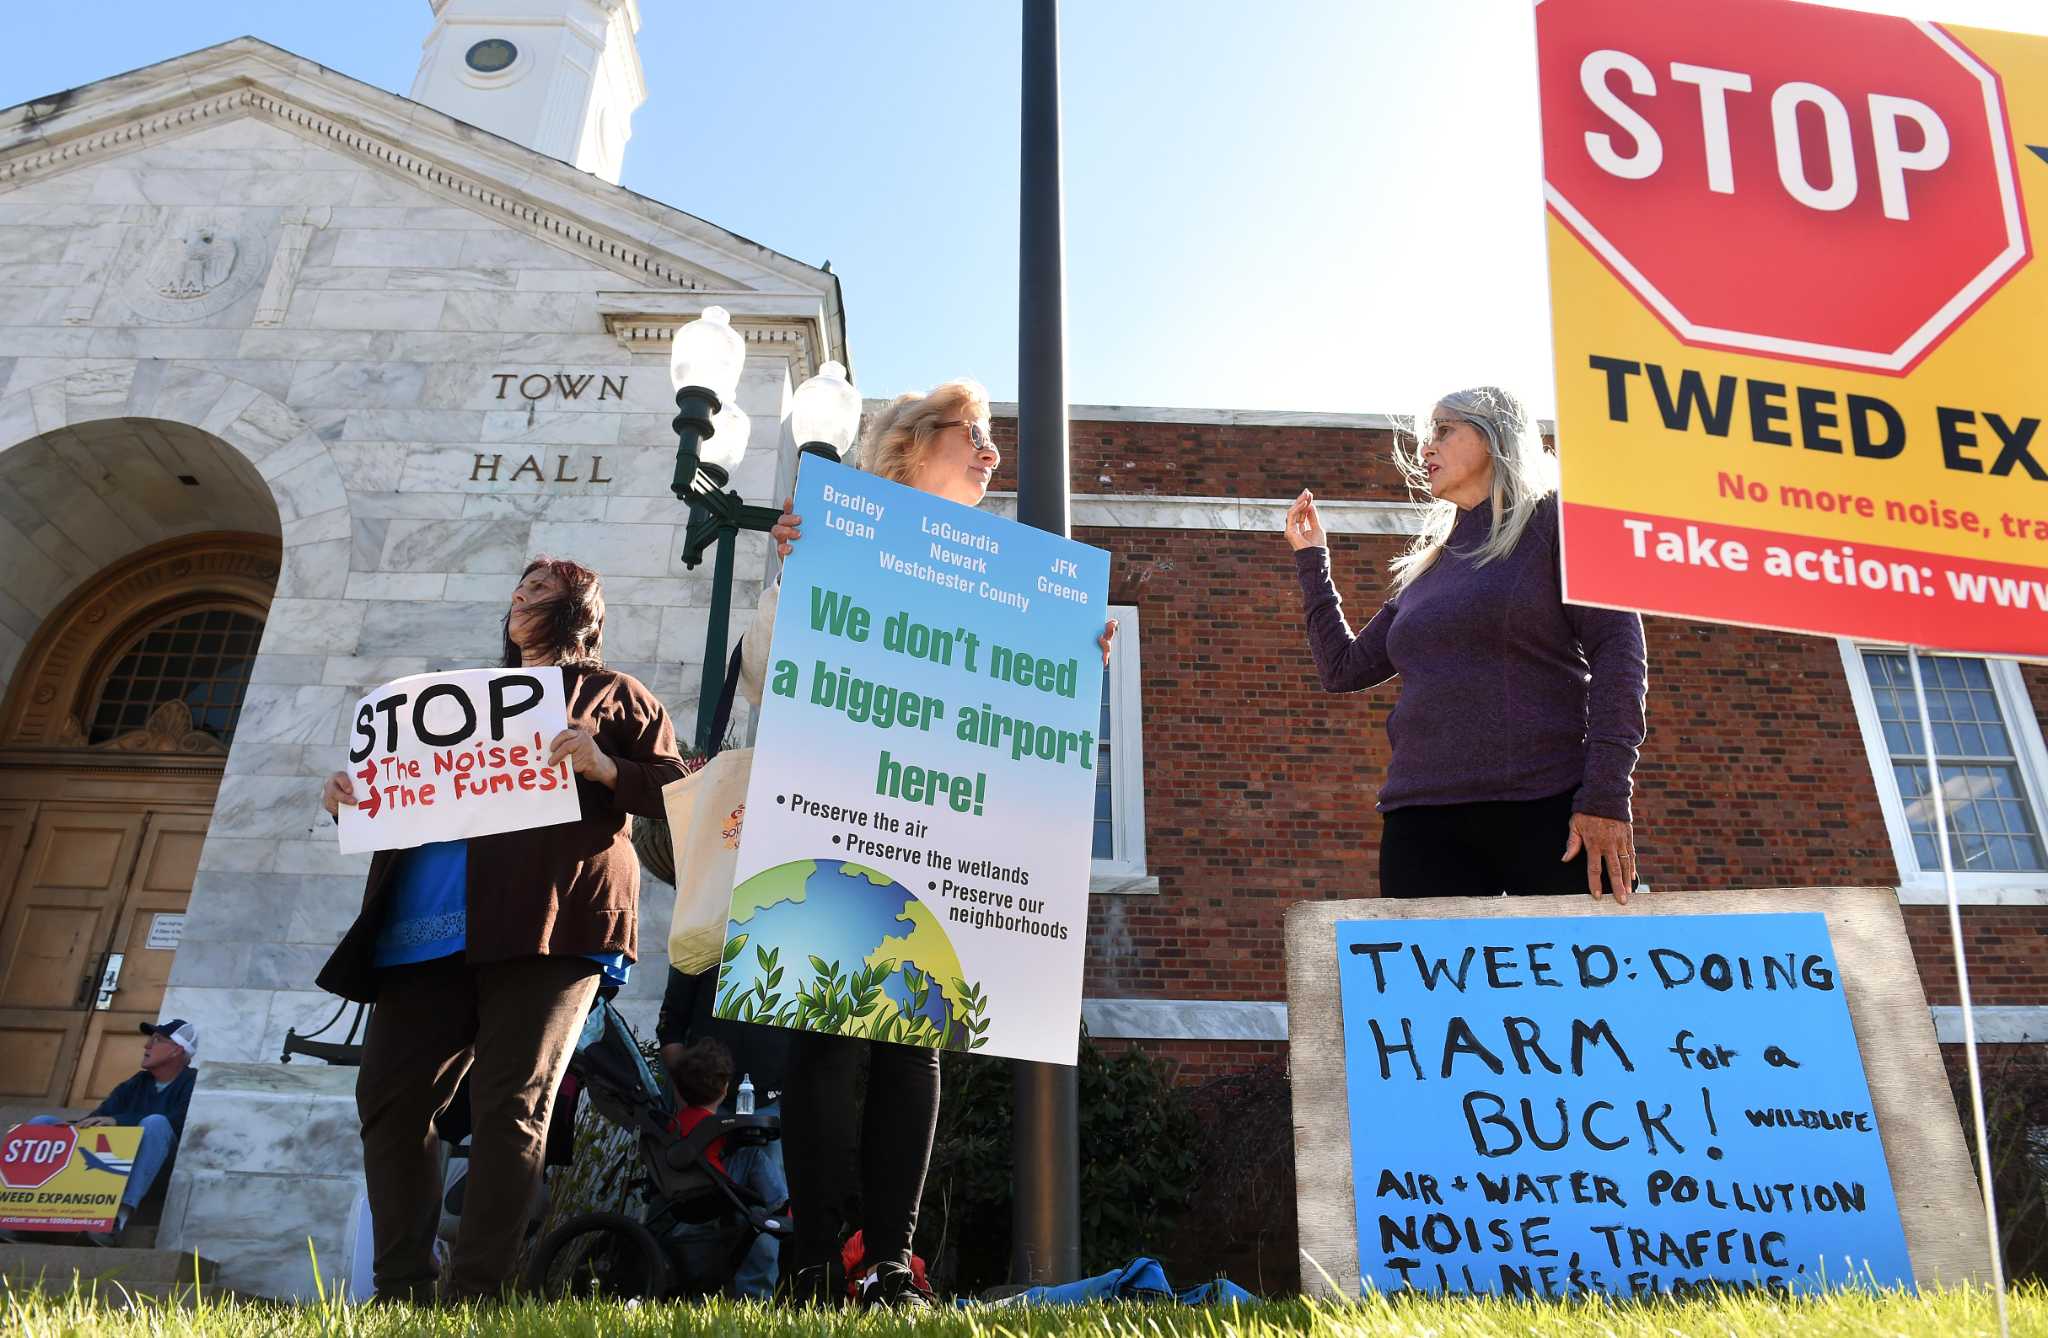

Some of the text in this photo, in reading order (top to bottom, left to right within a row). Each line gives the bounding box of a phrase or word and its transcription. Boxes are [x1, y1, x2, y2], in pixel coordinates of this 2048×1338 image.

[1580, 49, 1950, 221] STOP
[492, 373, 629, 401] TOWN
[1589, 354, 1907, 460] TWEED
[469, 454, 612, 483] HALL
[824, 484, 884, 521] Bradley
[826, 511, 875, 540] Logan
[1717, 471, 1768, 503] No
[1780, 485, 1874, 518] more
[1885, 499, 1990, 539] noise,
[922, 516, 999, 554] LaGuardia
[930, 543, 987, 574] Newark
[1623, 518, 1749, 572] Take
[1764, 546, 1936, 597] action:
[880, 551, 1030, 612] Westchester County
[1037, 576, 1089, 604] Greene
[1051, 558, 1078, 578] JFK
[810, 586, 1078, 699] We don't need
[350, 675, 544, 763] STOP
[771, 659, 1095, 770] a bigger airport
[381, 732, 542, 781] The Noise!
[384, 761, 568, 810] The Fumes!
[876, 750, 987, 816] here!
[791, 793, 928, 839] Preserve the air
[846, 833, 1030, 886] Preserve the wetlands
[942, 880, 1044, 914] Preserve our
[949, 905, 1068, 940] neighborhoods
[1350, 942, 1835, 993] TWEED: DOING
[1368, 1016, 1803, 1081] HARM for a
[1462, 1087, 1723, 1160] BUCK!
[1744, 1108, 1873, 1133] WILDLIFE
[4, 1139, 67, 1164] STOP
[38, 1192, 117, 1206] EXPANSION
[1376, 1168, 1444, 1205] AIR
[1476, 1170, 1627, 1209] WATER
[1647, 1170, 1866, 1214] POLLUTION
